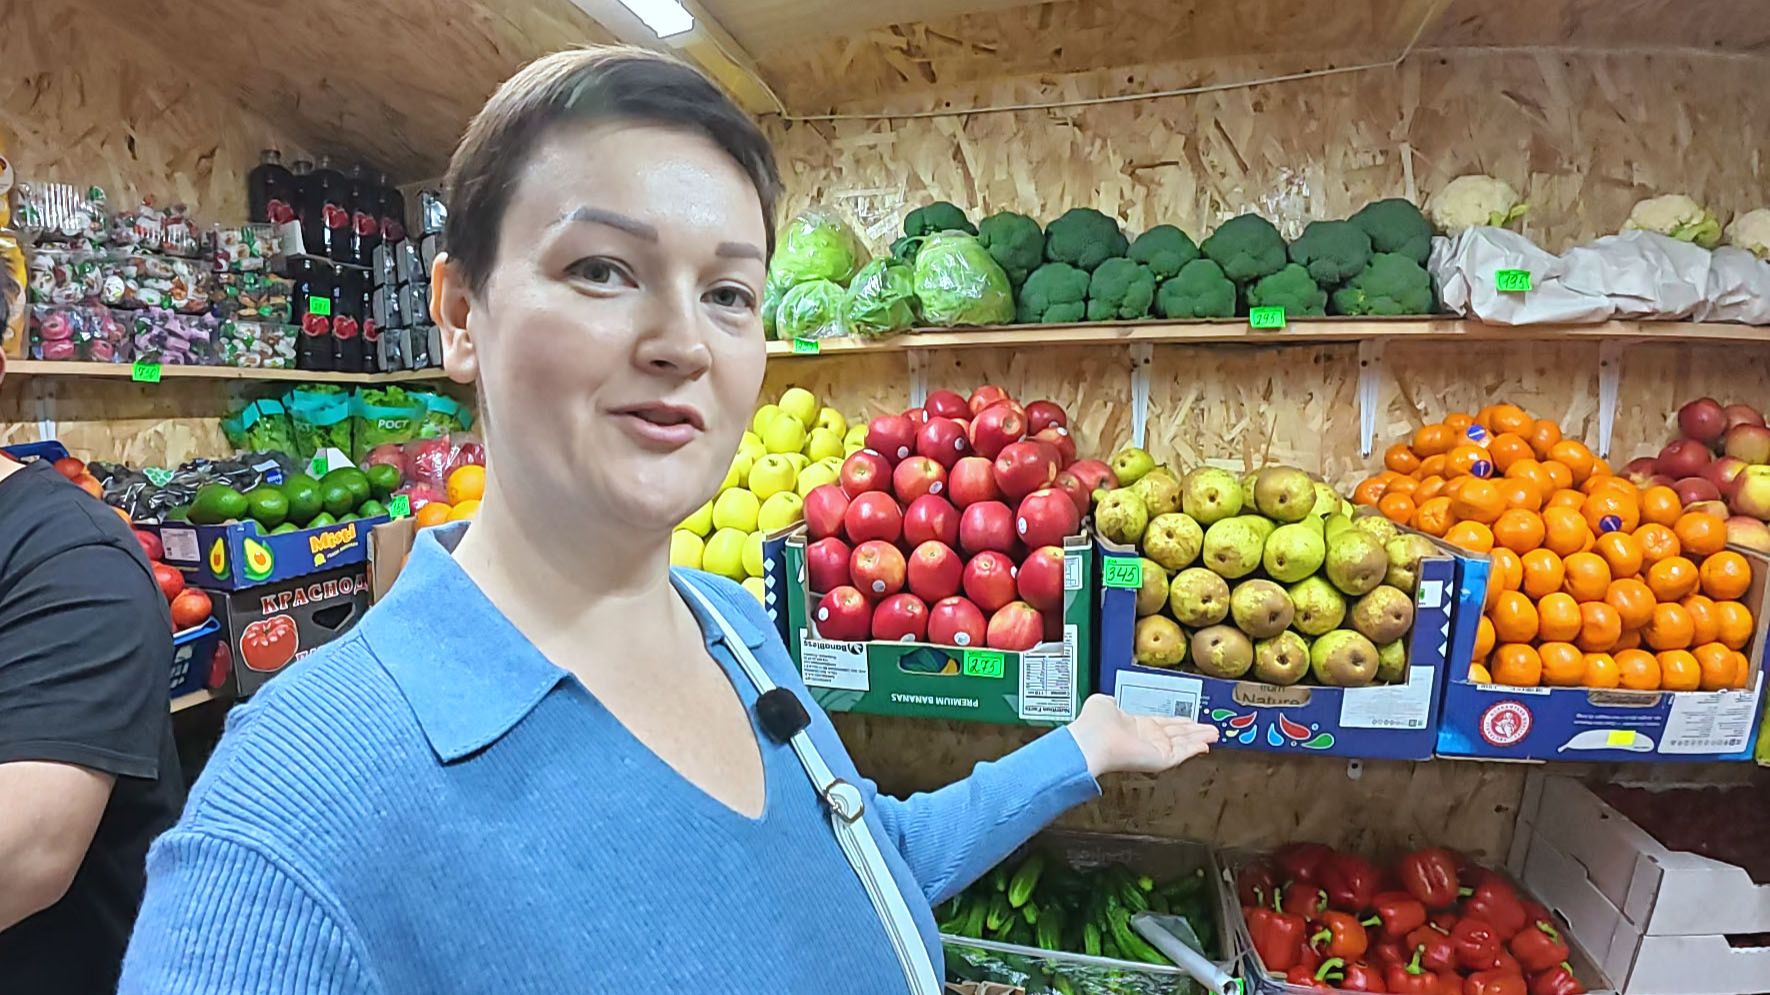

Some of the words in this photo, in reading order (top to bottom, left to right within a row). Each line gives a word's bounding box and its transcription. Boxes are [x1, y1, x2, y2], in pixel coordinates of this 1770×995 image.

[378, 419, 409, 430] РОСТ
[1107, 566, 1137, 582] 345
[970, 658, 999, 673] 275
[891, 693, 934, 705] BANANAS
[936, 695, 979, 708] PREMIUM
